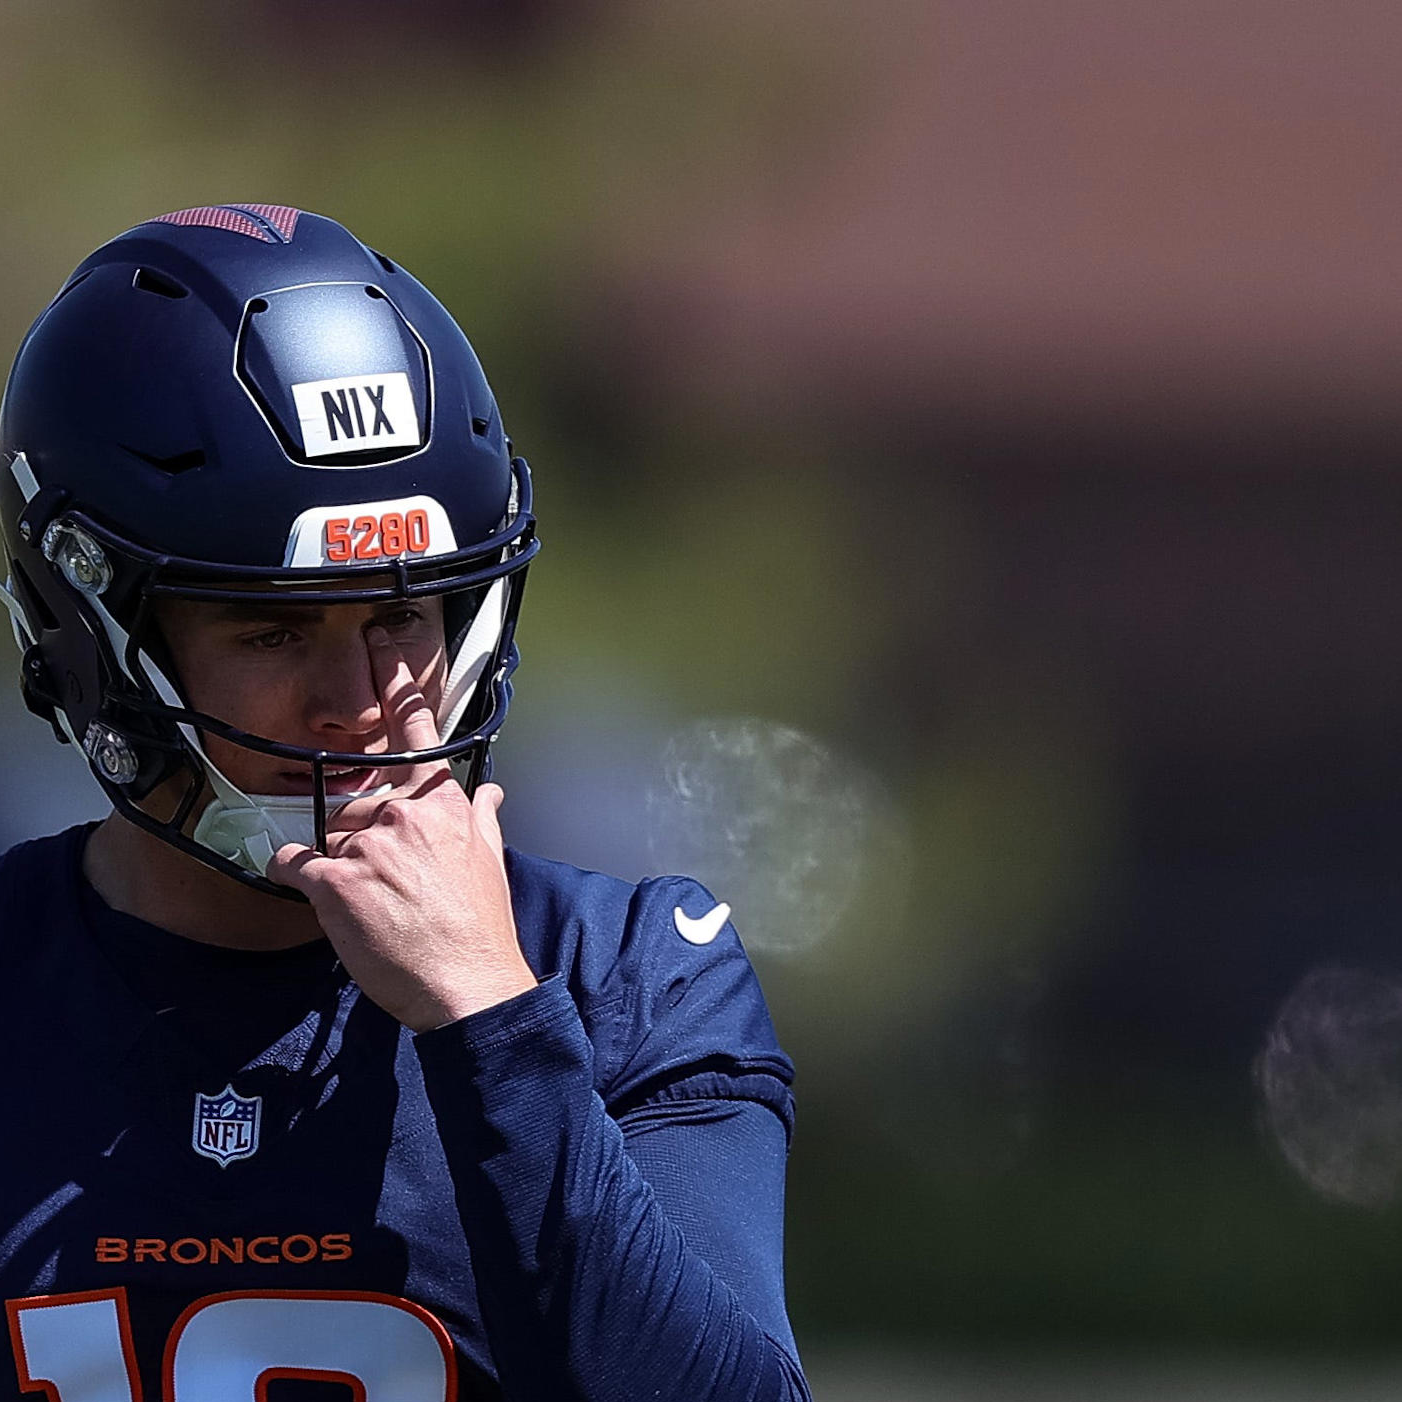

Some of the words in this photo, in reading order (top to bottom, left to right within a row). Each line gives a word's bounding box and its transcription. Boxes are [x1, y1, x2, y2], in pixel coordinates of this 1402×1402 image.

[322, 385, 396, 442] NIX
[325, 508, 430, 562] 5280
[202, 1121, 251, 1150] NFL
[95, 1233, 353, 1264] BRONCOS
